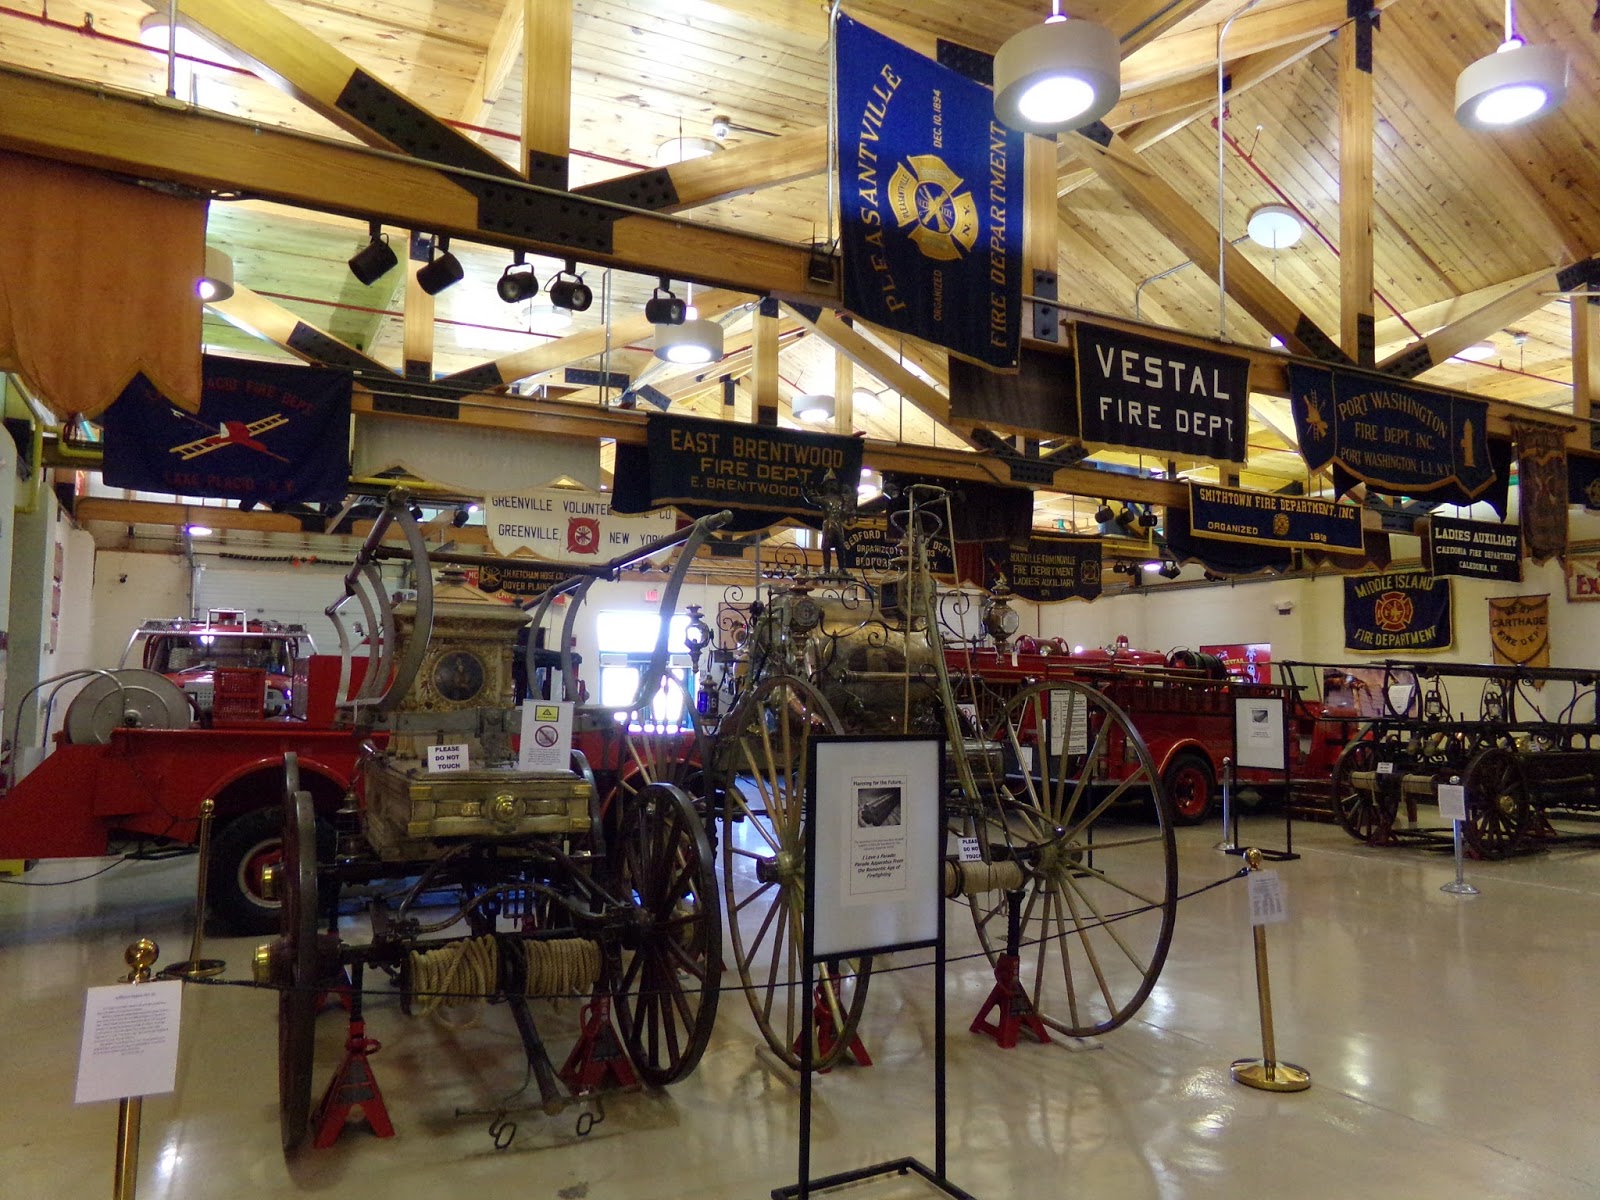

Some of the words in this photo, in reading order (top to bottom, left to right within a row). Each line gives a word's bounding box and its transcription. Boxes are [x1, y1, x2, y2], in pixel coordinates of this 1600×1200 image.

[857, 63, 906, 313] PLEASANTVILLE
[898, 173, 910, 219] PLEASANTVILLE
[990, 120, 1007, 288] DEPARTMENT
[932, 270, 943, 321] ORGANIZED
[990, 293, 1007, 349] FIRE
[1095, 344, 1230, 400] VESTAL
[1100, 397, 1162, 430] FIRE
[1175, 408, 1234, 442] DEPT.
[1337, 393, 1369, 421] PORT
[1370, 391, 1449, 439] WASHINGTON
[1354, 421, 1378, 441] FIRE
[1384, 427, 1412, 446] DEPT.
[1415, 431, 1435, 450] INC.
[670, 429, 719, 454] EAST
[733, 436, 844, 469] BRENTWOOD
[1340, 448, 1362, 464] PORT
[1364, 454, 1416, 472] WASHINGTON
[700, 457, 747, 478] FIRE
[690, 476, 703, 488] E.
[491, 496, 553, 512] GREENVILLE
[563, 500, 613, 517] VOLUNTEE
[1199, 488, 1252, 508] SMITHTOWN
[1255, 495, 1276, 510] FIRE
[609, 531, 630, 545] NEW
[1207, 521, 1259, 535] ORGANIZED
[1435, 527, 1471, 542] LADIES
[1473, 532, 1517, 547] AUXILIARY
[844, 529, 881, 550] BEDFORD
[1469, 548, 1482, 557] FIRE
[1013, 565, 1028, 575] FIRE
[1030, 566, 1075, 576] DEPARTMENT
[502, 581, 526, 590] DOVER
[1013, 577, 1040, 586] LADIES
[1040, 578, 1075, 588] AUXILIARY
[1354, 575, 1394, 599] MIDDLE
[1395, 574, 1434, 591] ISLAND
[1492, 616, 1547, 628] CARTHAGE
[1354, 628, 1373, 645] FIRE
[1375, 625, 1436, 647] DEPARTMENT
